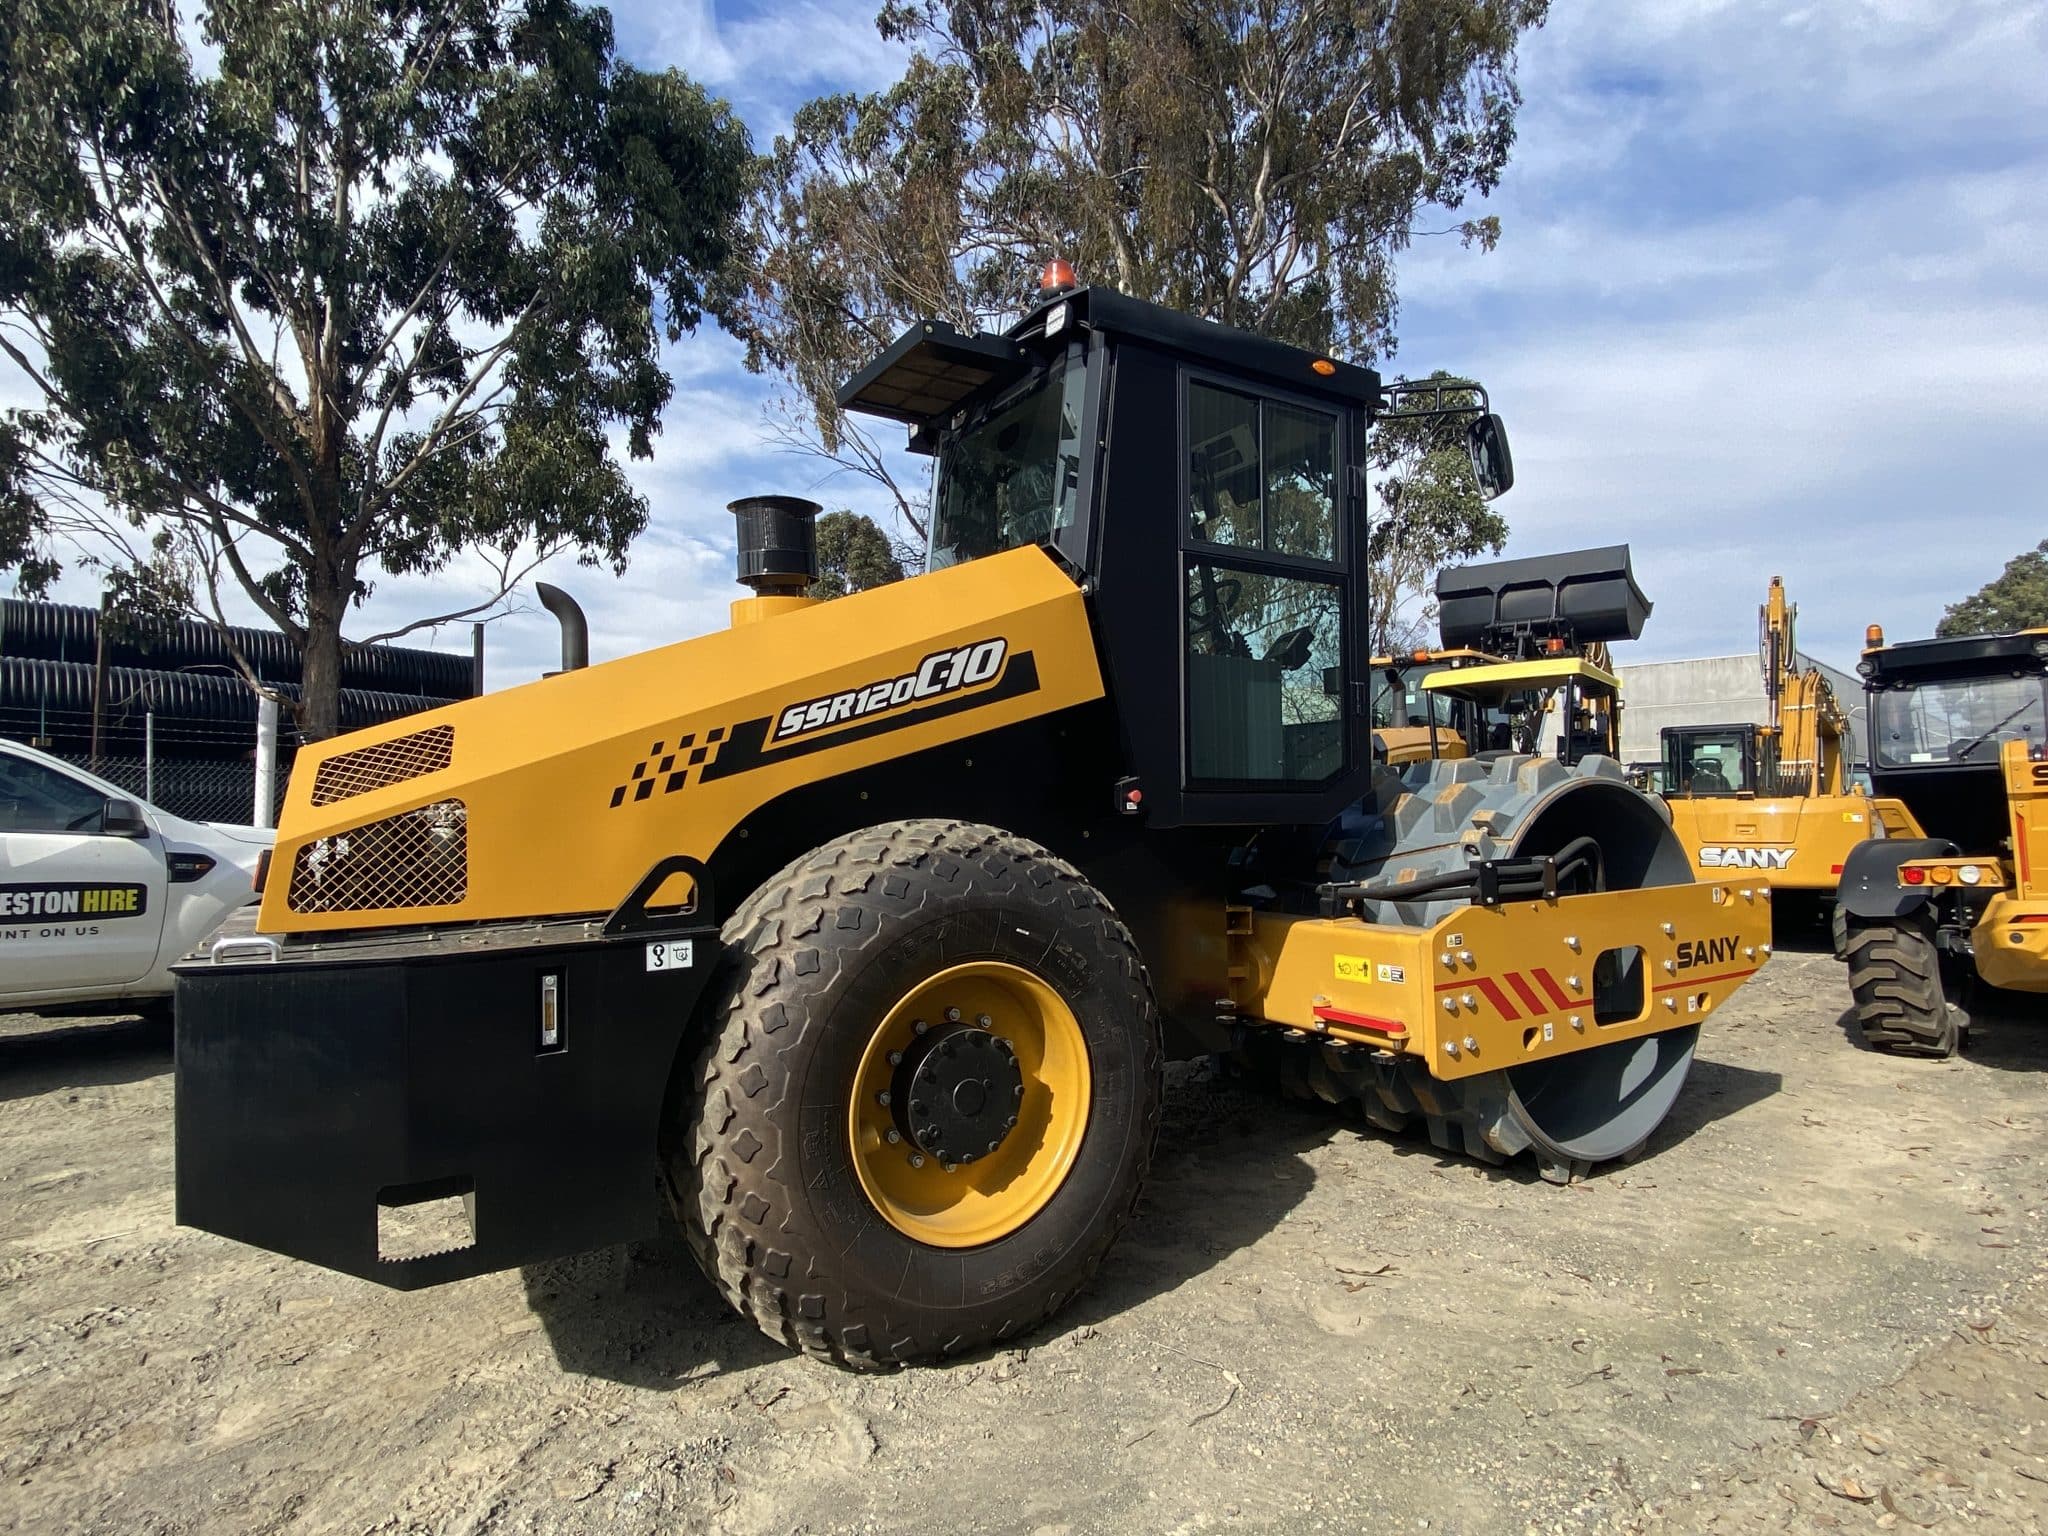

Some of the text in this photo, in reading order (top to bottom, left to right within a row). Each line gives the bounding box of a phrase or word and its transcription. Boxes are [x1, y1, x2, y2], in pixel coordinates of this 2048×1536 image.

[1699, 847, 1797, 869] SANY
[83, 889, 138, 912] HIRE
[0, 926, 99, 940] NT ON US
[1677, 935, 1740, 969] SANY
